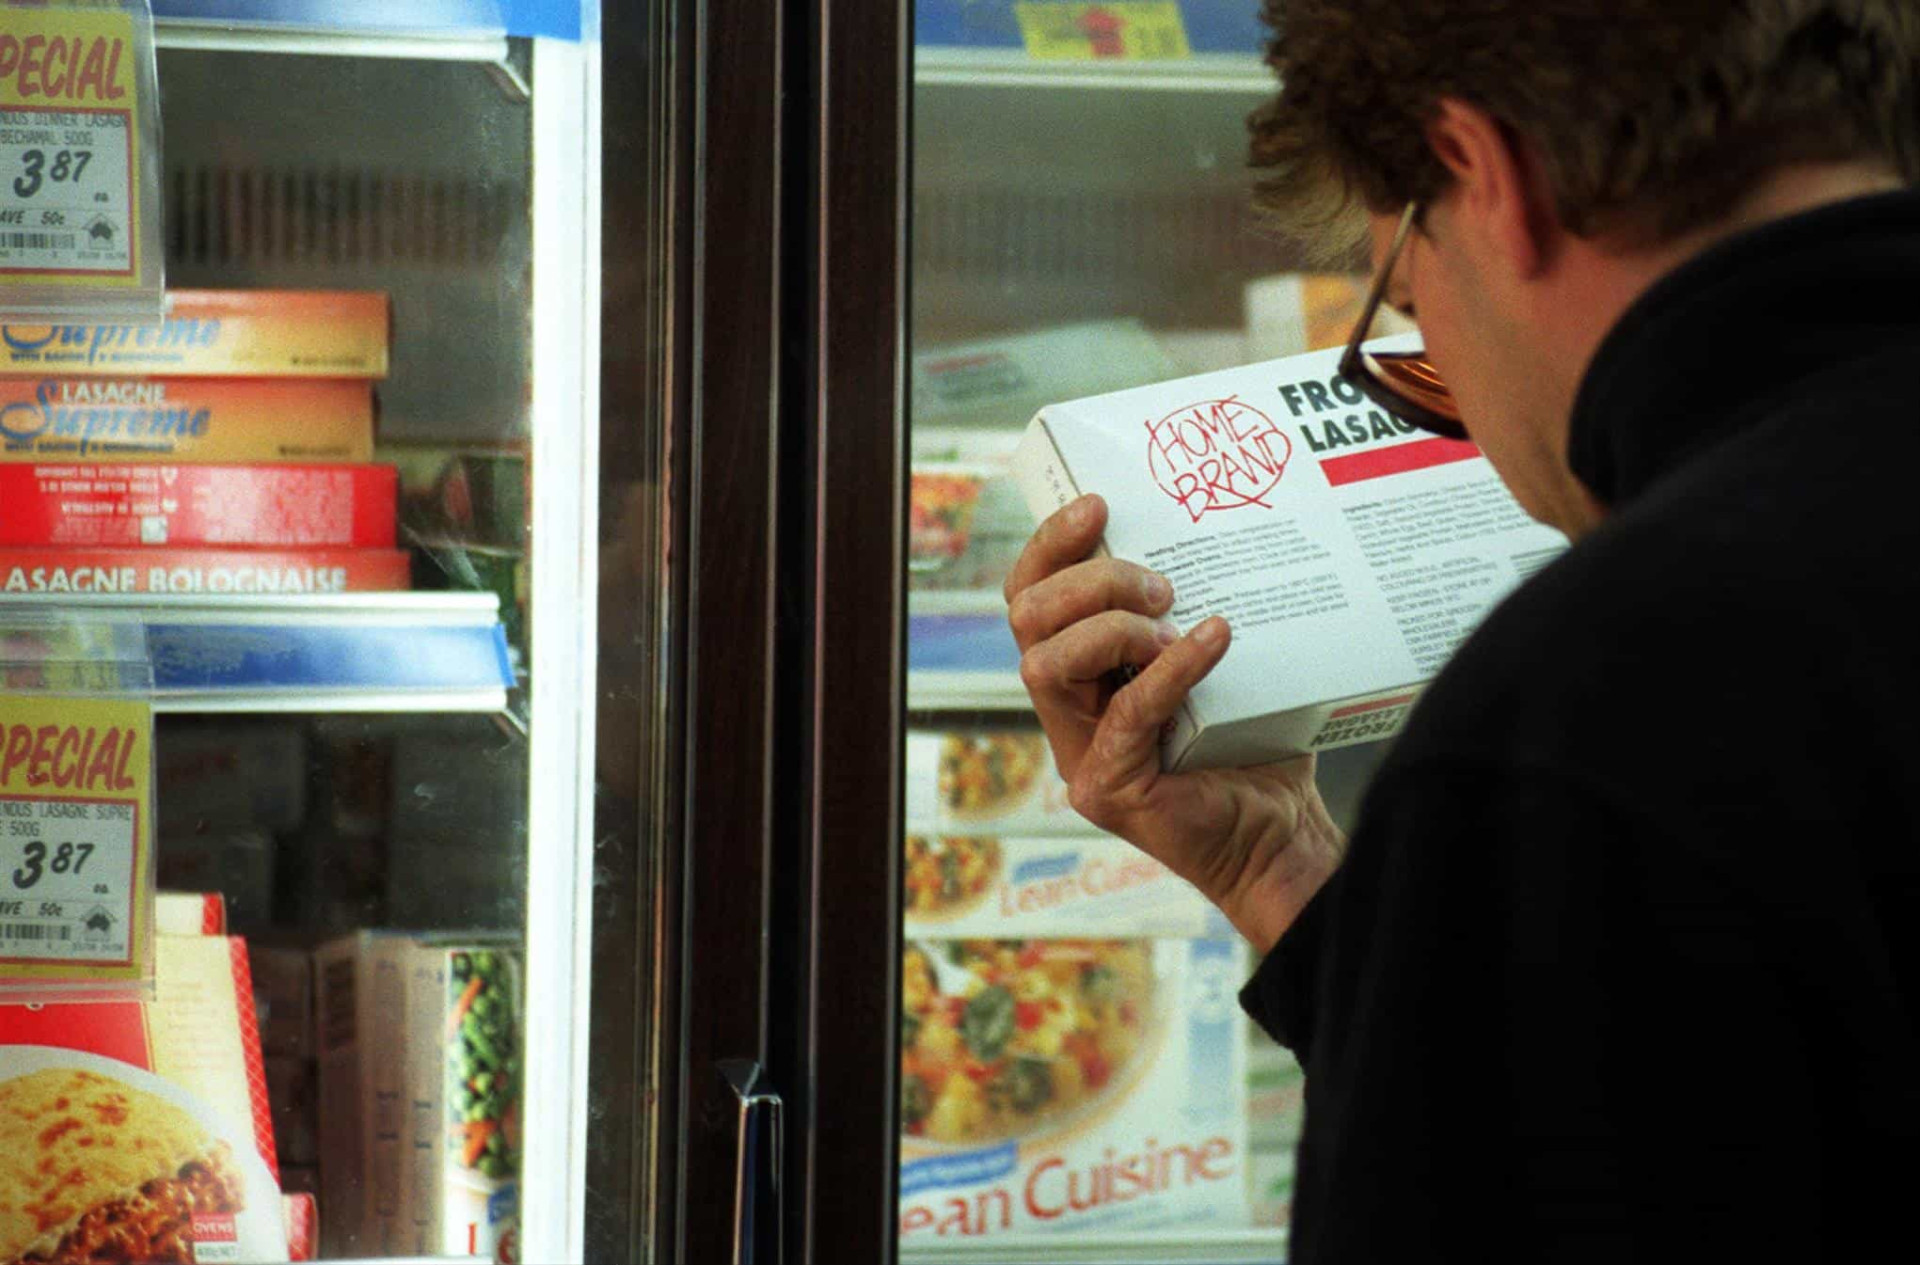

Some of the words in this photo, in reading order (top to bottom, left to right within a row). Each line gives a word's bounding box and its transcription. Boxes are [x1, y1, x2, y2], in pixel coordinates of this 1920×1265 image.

[0, 377, 212, 458] Supreme
[62, 381, 166, 403] LASAGNE
[1145, 394, 1260, 474] HOME
[1172, 428, 1293, 524] BRAND
[4, 566, 138, 593] ASAGNE
[148, 566, 347, 593] BOLOGNAISE
[0, 722, 136, 791] PECIAL
[10, 821, 40, 838] 500G
[40, 803, 89, 820] LASAGNE
[1024, 1136, 1234, 1221] Cuisine
